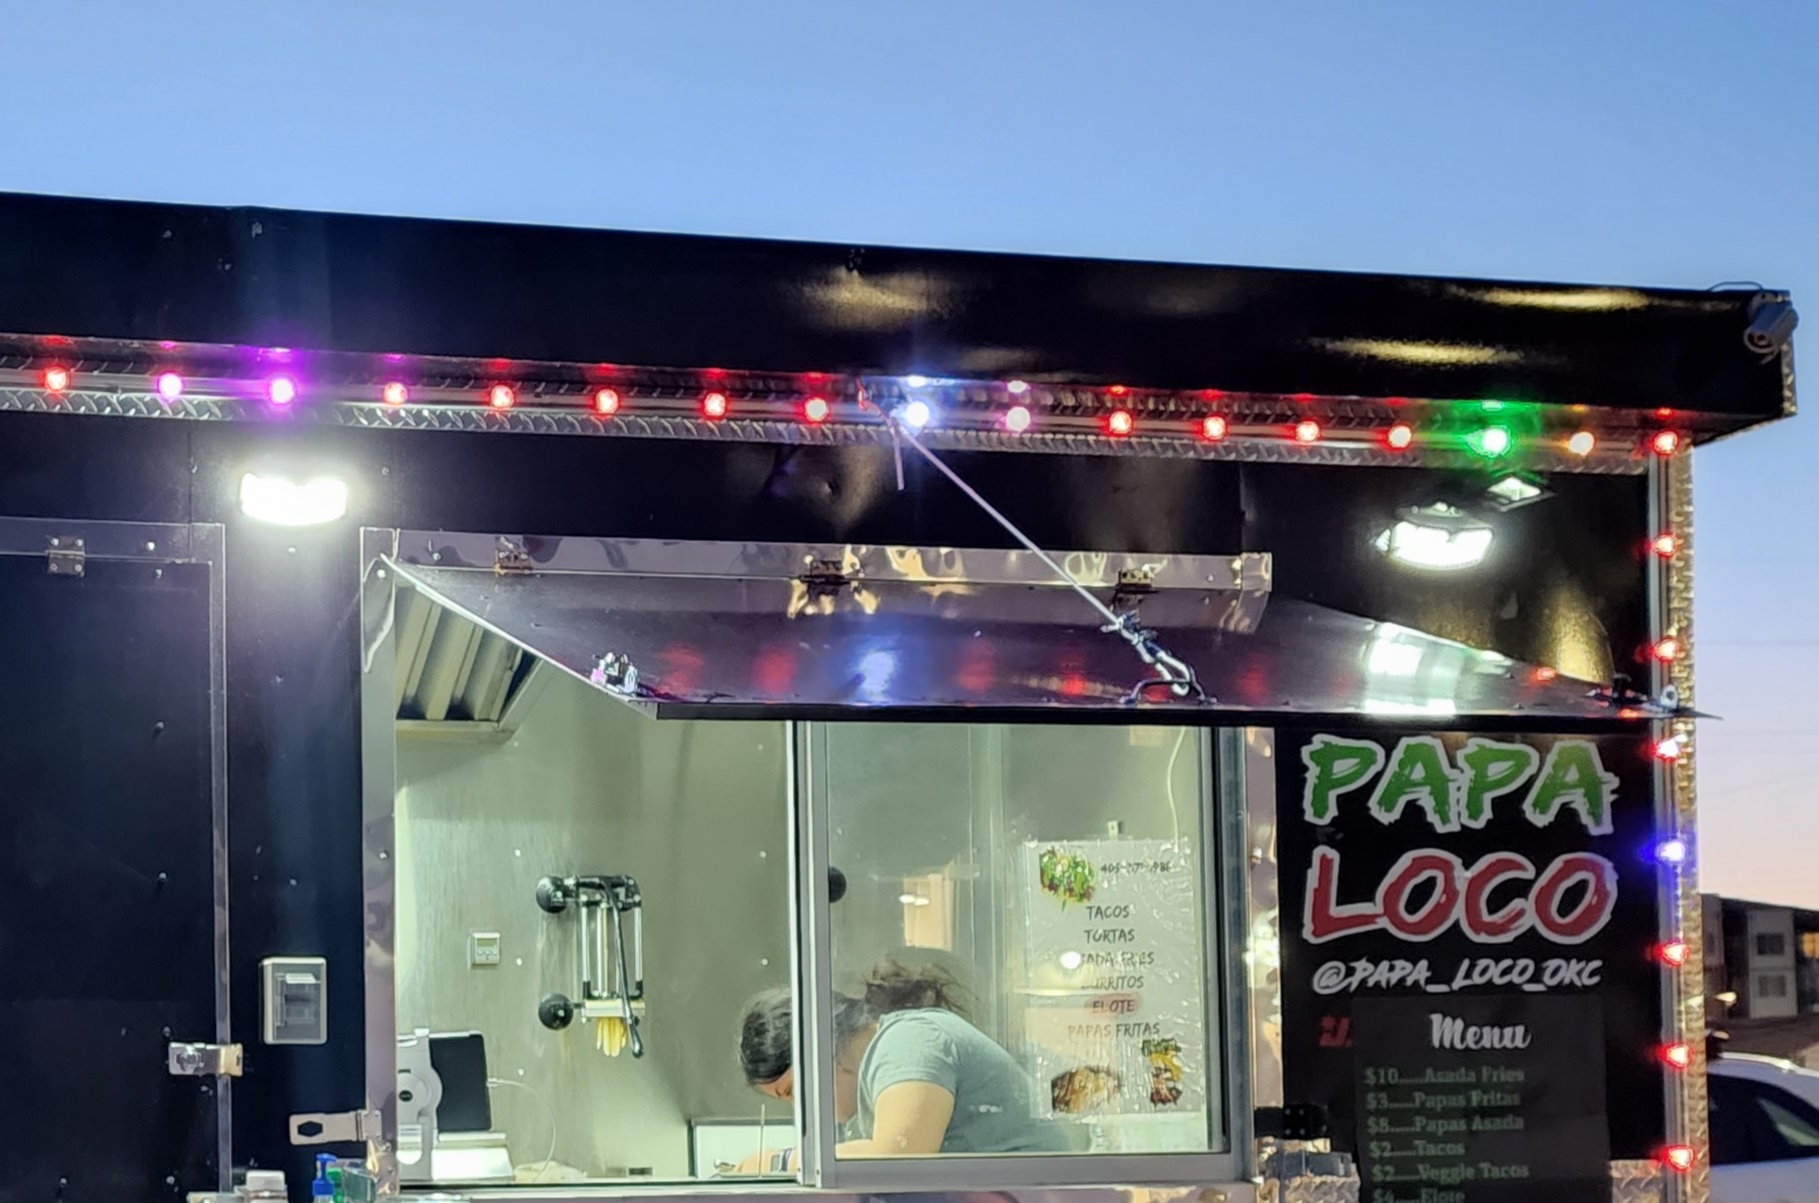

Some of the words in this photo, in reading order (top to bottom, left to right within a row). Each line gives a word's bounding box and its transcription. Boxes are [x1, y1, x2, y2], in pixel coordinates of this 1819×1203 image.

[1301, 734, 1620, 835] PAPA
[1303, 845, 1618, 945] LOCO
[1086, 905, 1130, 921] TACOS
[1084, 929, 1136, 944] TORTAS
[1068, 1024, 1111, 1038] PAPAS
[1116, 1022, 1160, 1038] FRITAS
[1430, 1013, 1532, 1049] Menu
